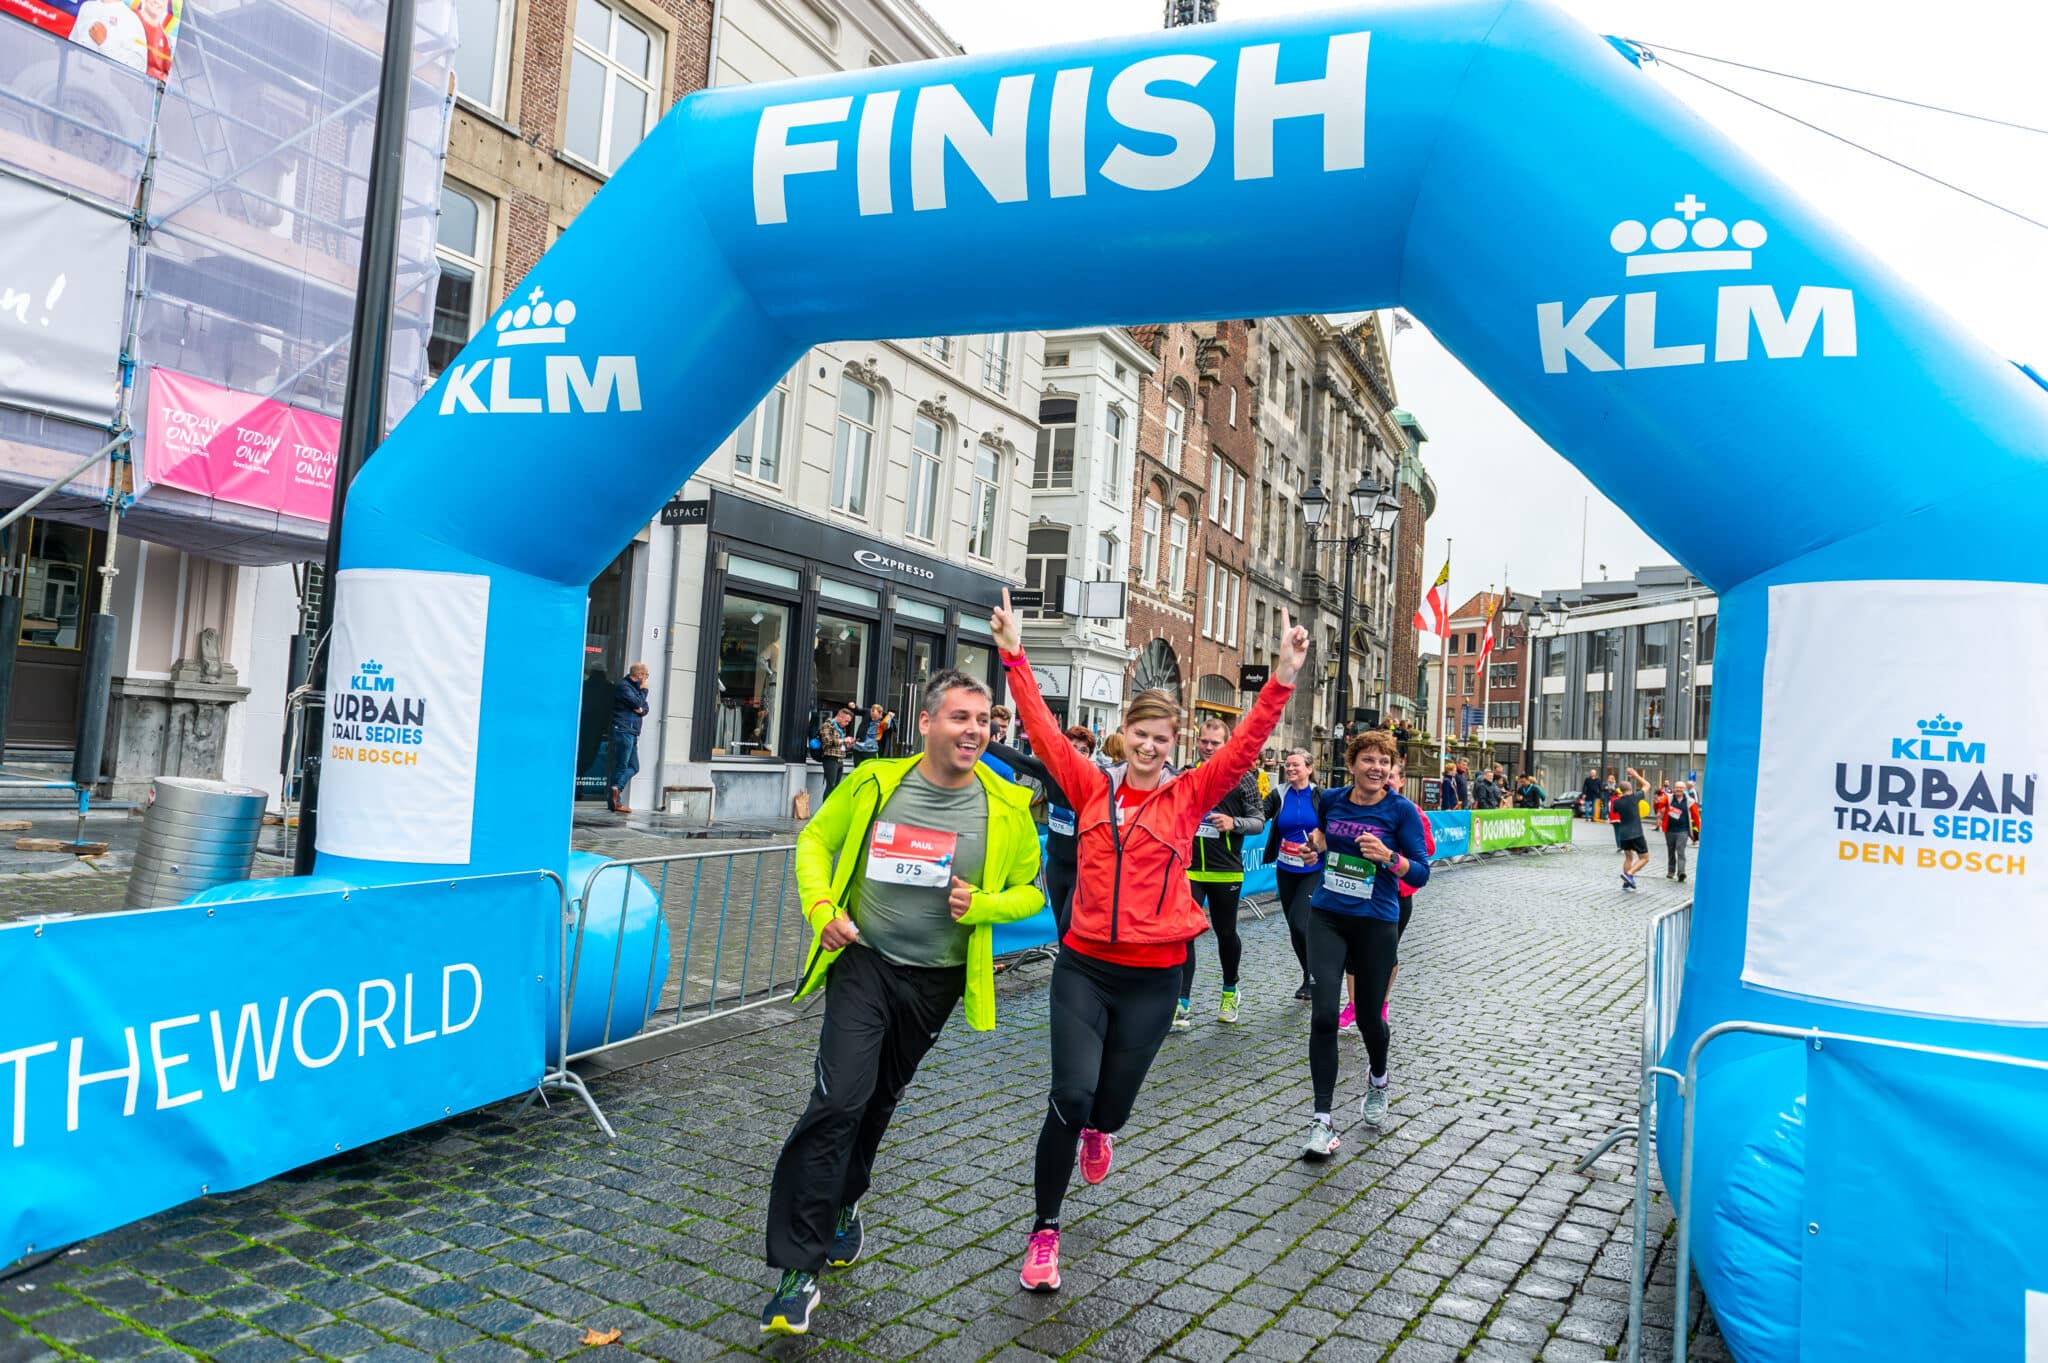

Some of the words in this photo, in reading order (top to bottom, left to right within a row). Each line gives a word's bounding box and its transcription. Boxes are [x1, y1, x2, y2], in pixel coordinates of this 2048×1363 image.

[752, 31, 1371, 225] FINISH
[1537, 284, 1858, 374] KLM
[439, 355, 642, 415] KLM
[162, 407, 222, 434] TODAY
[166, 426, 213, 448] ONLY
[236, 426, 281, 452] TODAY
[235, 445, 273, 466] ONLY
[293, 443, 339, 466] TODAY
[295, 461, 333, 480] ONLY
[666, 507, 705, 518] ASPACT
[653, 627, 659, 638] 9
[351, 675, 395, 692] KLM
[334, 693, 425, 727] URBAN
[332, 722, 362, 741] TRAIL
[365, 726, 423, 745] SERIES
[332, 745, 354, 761] DEN
[358, 748, 417, 766] BOSCH
[1891, 737, 1986, 764] KLM
[1835, 762, 2036, 816] URBAN
[1482, 818, 1526, 841] DOORNBOS
[1834, 806, 1925, 837] TRAIL
[1932, 814, 2033, 845] SERIES
[910, 840, 934, 850] PAUL
[896, 863, 922, 876] 875
[1838, 840, 1905, 866] DEN
[1917, 847, 2026, 876] BOSCH
[1334, 878, 1357, 890] 1205
